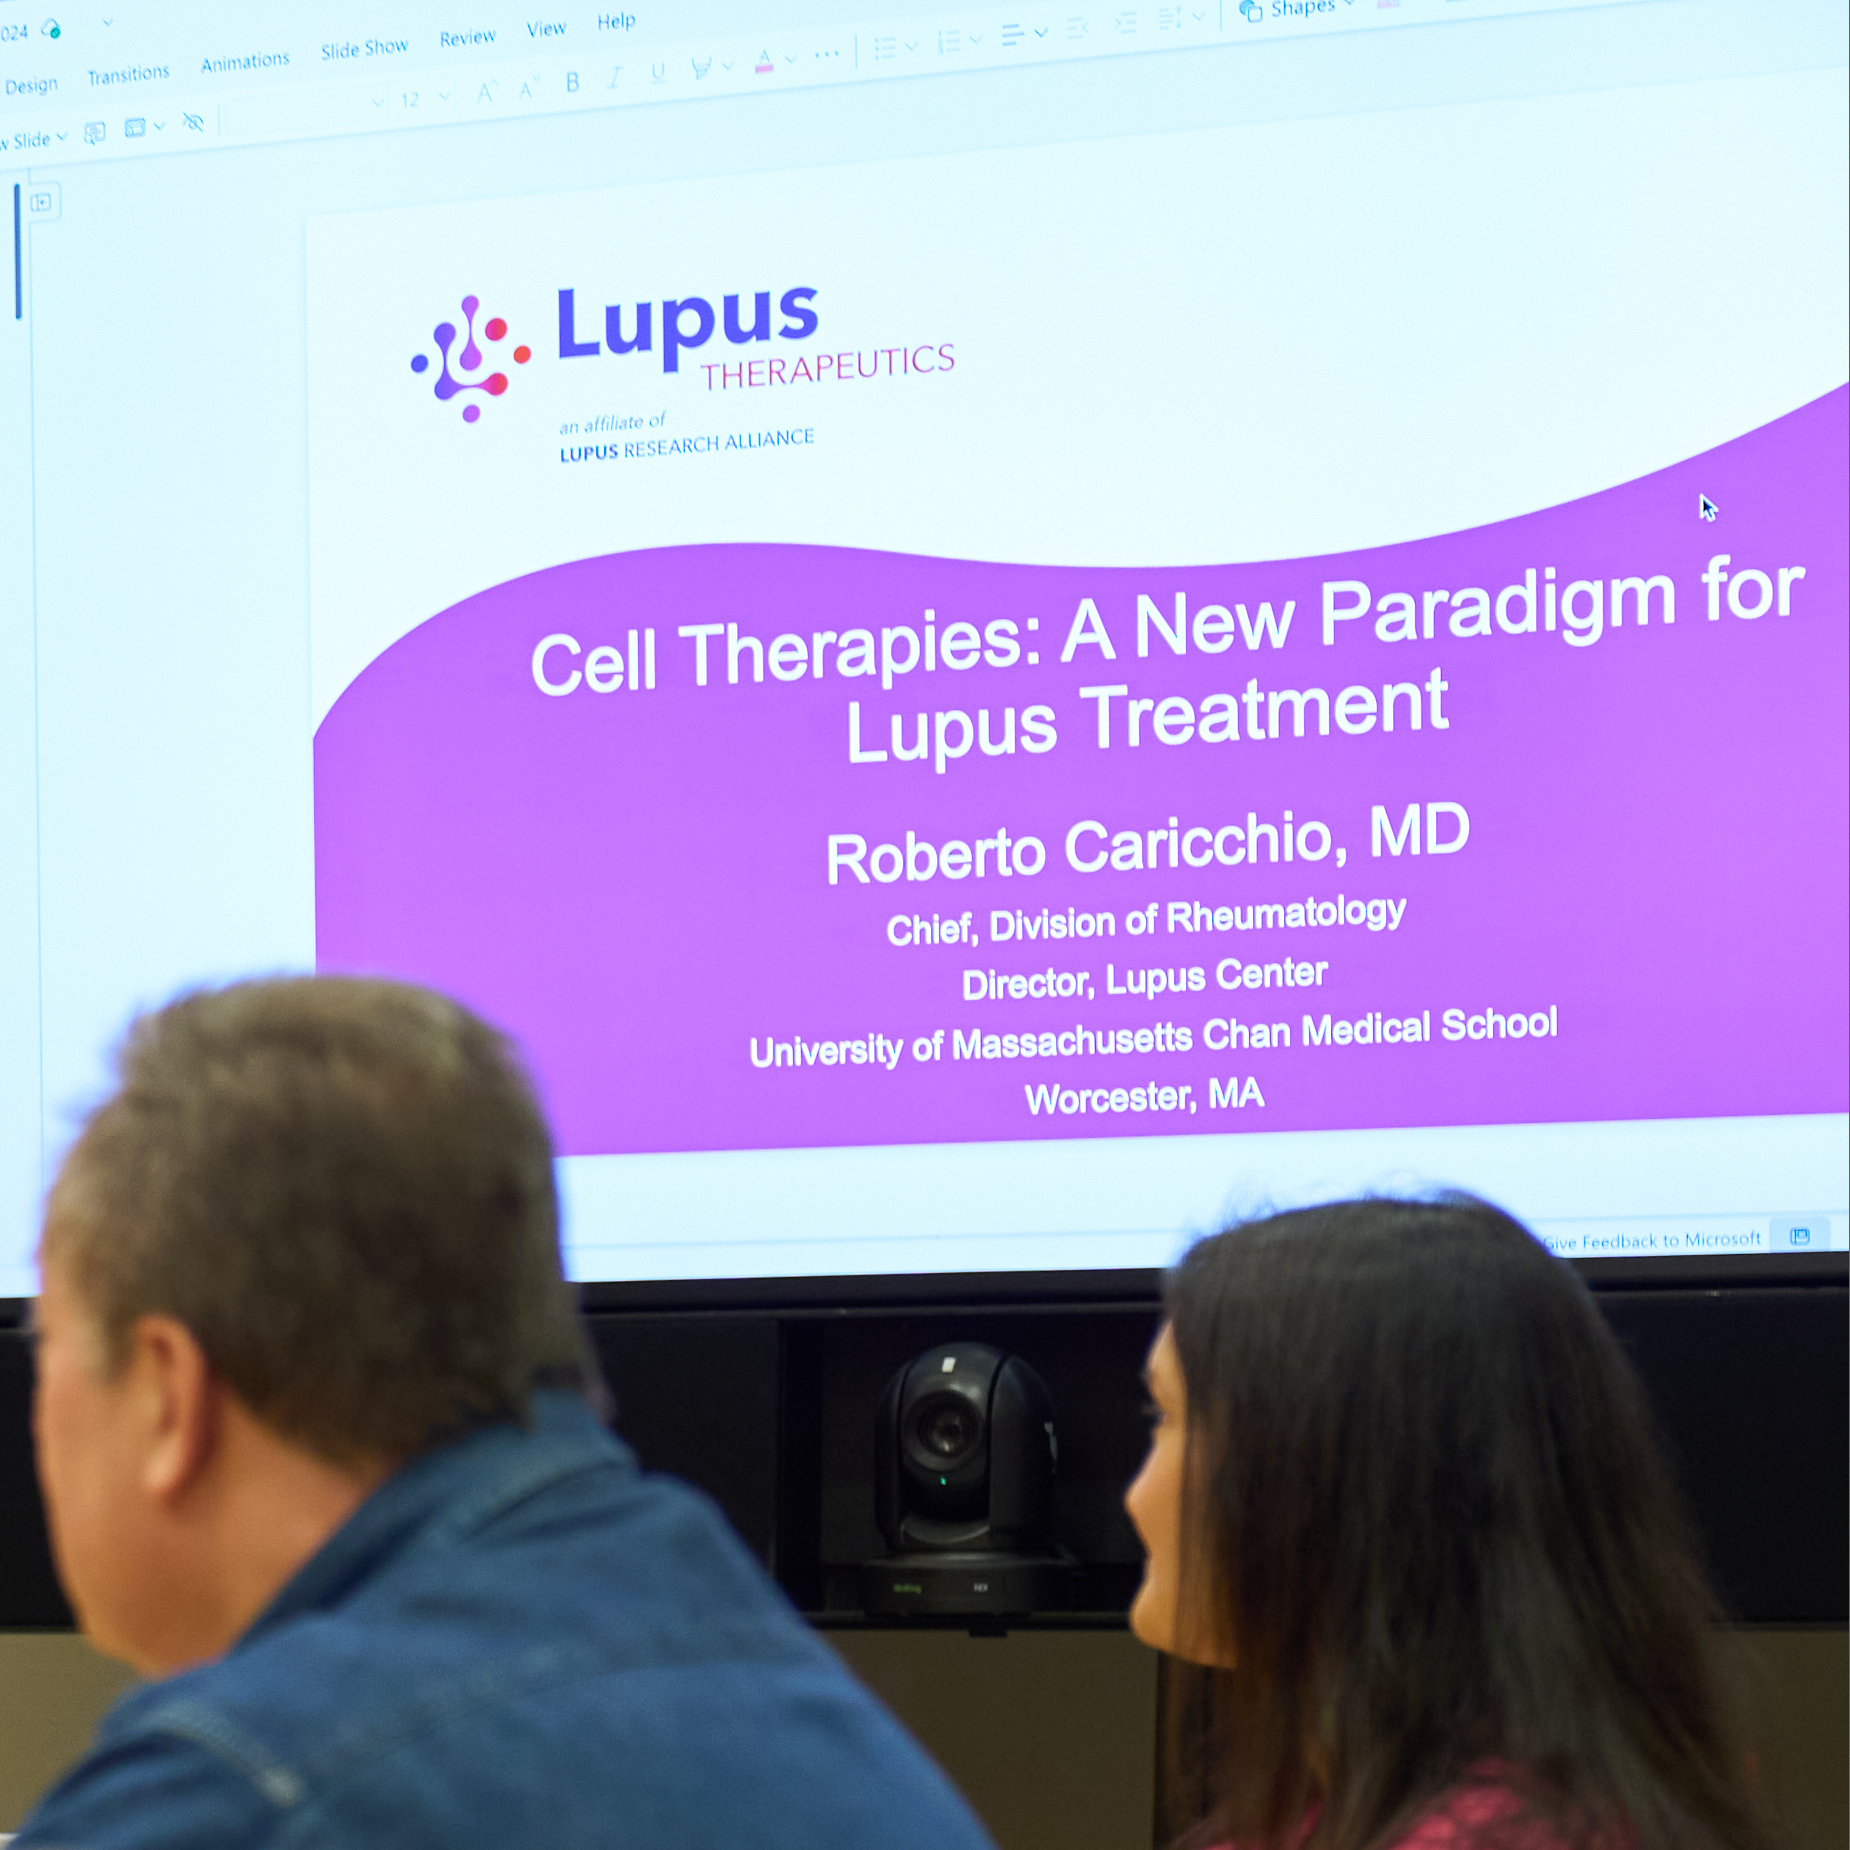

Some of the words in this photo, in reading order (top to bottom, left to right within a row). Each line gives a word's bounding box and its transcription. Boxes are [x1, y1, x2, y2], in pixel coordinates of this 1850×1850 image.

[598, 10, 636, 33] Help
[1271, 0, 1336, 19] Shapes
[440, 27, 497, 48] Review
[526, 19, 567, 38] View
[320, 41, 360, 61] Slide
[364, 37, 409, 57] Show
[87, 64, 170, 86] Transitions
[200, 51, 291, 74] Animations
[5, 75, 58, 97] Design
[401, 91, 420, 108] 12
[13, 130, 51, 150] Slide
[558, 286, 819, 374] Lupus
[701, 343, 957, 392] THERAPEUTICS
[559, 420, 580, 436] an
[584, 413, 644, 434] affiliate
[648, 409, 669, 429] of
[560, 442, 620, 464] LUPUS
[623, 435, 721, 460] RESEARCH
[724, 427, 816, 452] ALLIANCE
[530, 626, 657, 698] Cell
[677, 608, 1040, 691] Therapies:
[1060, 597, 1118, 663] A
[1136, 591, 1297, 658] New
[1321, 566, 1677, 648] Paradigm
[1700, 553, 1808, 622] for
[848, 700, 1059, 776] Lupus
[1079, 666, 1451, 750] Treatment
[826, 826, 1046, 886] Roberto
[1064, 810, 1348, 875] Caricchio,
[1370, 801, 1472, 858] MD
[887, 909, 980, 947] Chief,
[990, 906, 1117, 943] Division
[1124, 902, 1159, 936] of
[1166, 894, 1408, 934] Rheumatology
[962, 966, 1096, 1001] Director,
[1106, 962, 1207, 1000] Lupus
[1215, 956, 1330, 990] Center
[749, 1032, 905, 1071] University
[912, 1029, 946, 1062] of
[952, 1022, 1195, 1061] Massachusetts
[1202, 1017, 1292, 1050] Chan
[1301, 1010, 1431, 1047] Medical
[1440, 1004, 1559, 1041] School
[1023, 1081, 1198, 1116] Worcester,
[1207, 1075, 1266, 1109] MA
[1543, 1235, 1577, 1250] Give
[1583, 1232, 1657, 1250] Feedback
[1663, 1233, 1680, 1248] to
[1685, 1229, 1761, 1248] Microsoft
